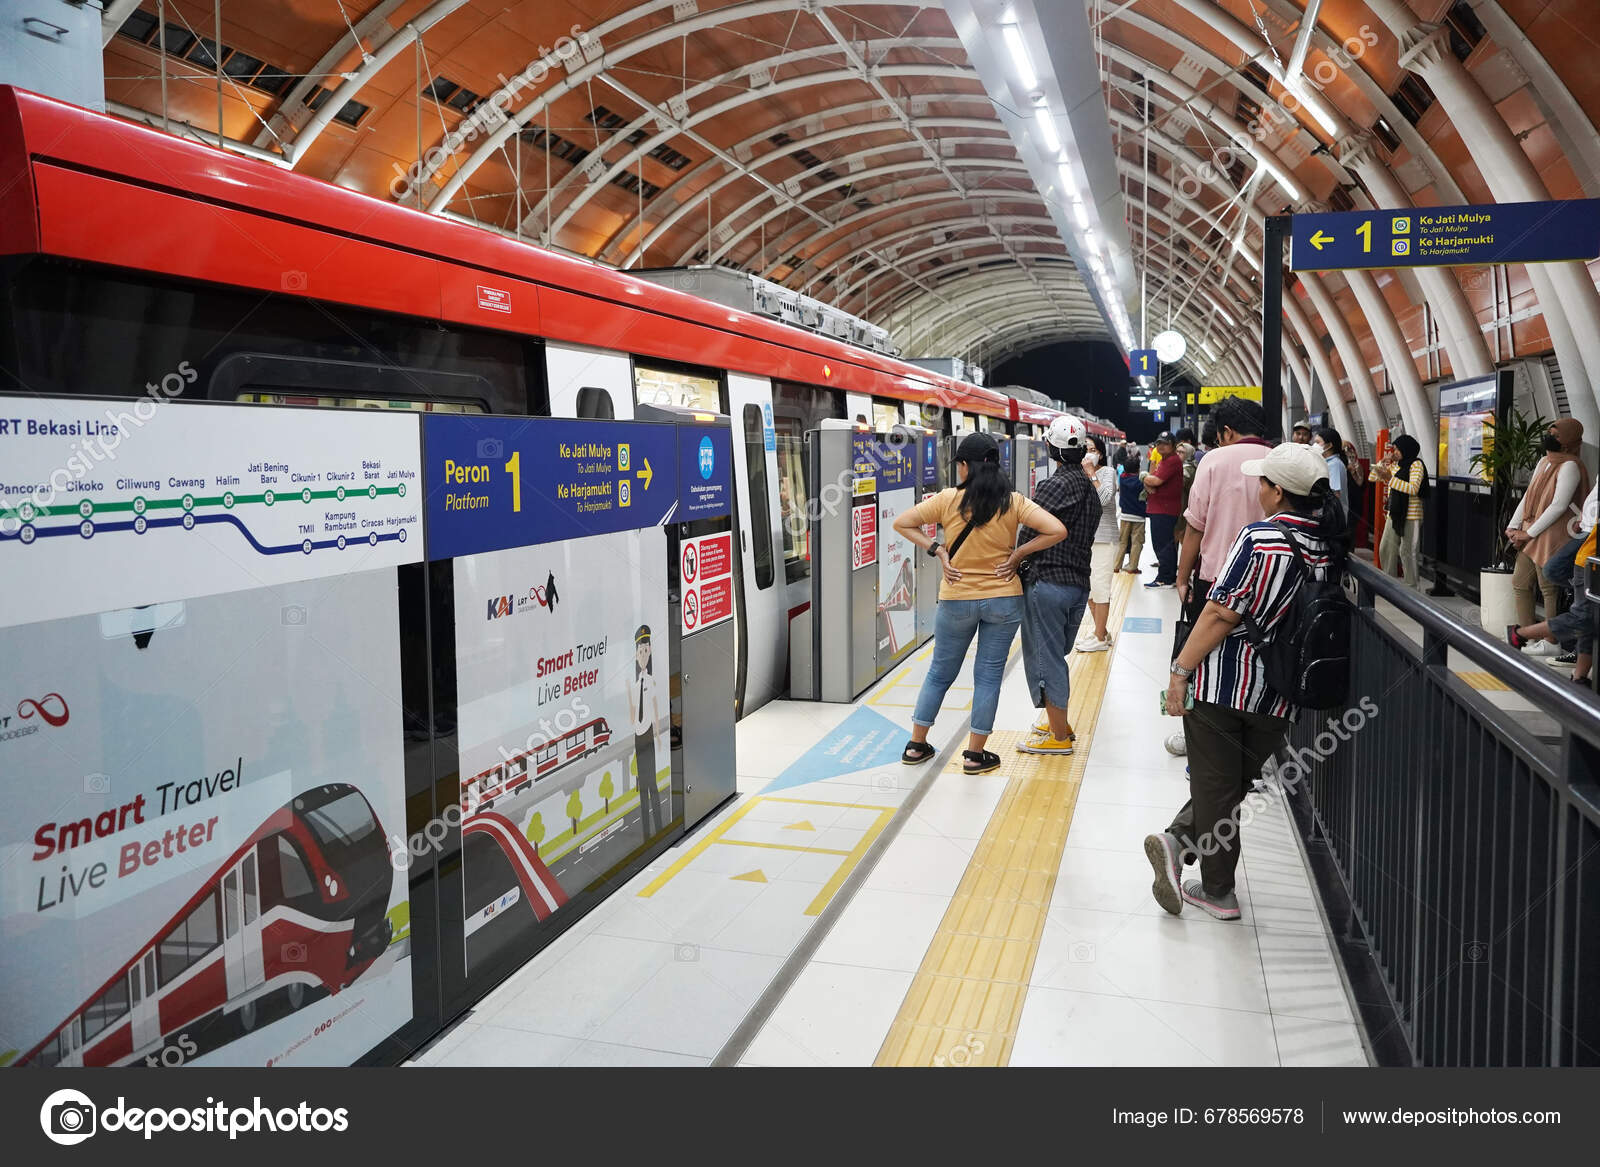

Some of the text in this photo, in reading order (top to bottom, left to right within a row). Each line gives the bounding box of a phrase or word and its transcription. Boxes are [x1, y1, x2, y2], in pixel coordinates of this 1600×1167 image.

[1420, 213, 1491, 225] Ke Jati Mulya
[1356, 221, 1371, 252] 1
[1419, 235, 1494, 247] Ke Harjamukti
[1429, 247, 1470, 256] Harjamukti
[1139, 355, 1148, 370] 1
[27, 420, 81, 436] Bekasi
[86, 421, 119, 436] Line
[560, 443, 611, 460] Ke Jati Mulya
[248, 462, 289, 473] Jati Bening
[362, 460, 381, 469] Bekasi
[578, 463, 612, 474] To Jati Mulya
[326, 472, 355, 481] Cikunir 2
[364, 471, 380, 480] Barat
[387, 470, 415, 481] Jati Mulya
[445, 459, 490, 484] Peron
[116, 478, 160, 490] Ciliwung
[169, 477, 205, 489] Cawang
[216, 476, 240, 486] Halim
[261, 474, 277, 483] Baru
[291, 473, 321, 483] Cikunir 1
[505, 451, 521, 512] 1
[66, 480, 104, 492] Cikoko
[558, 481, 612, 500] Ke Harjamukti
[445, 492, 489, 511] Platform
[577, 500, 612, 514] To Harjamukti
[325, 511, 356, 522] Kampung
[386, 514, 417, 526] Harjamukti
[324, 521, 357, 532] Rambutan
[361, 518, 384, 528] Ciracas
[487, 594, 514, 620] KAI
[536, 635, 608, 678] Smart Travel
[538, 668, 599, 706] Live Better
[32, 757, 242, 862] Smart Travel
[37, 816, 219, 912] Live Better
